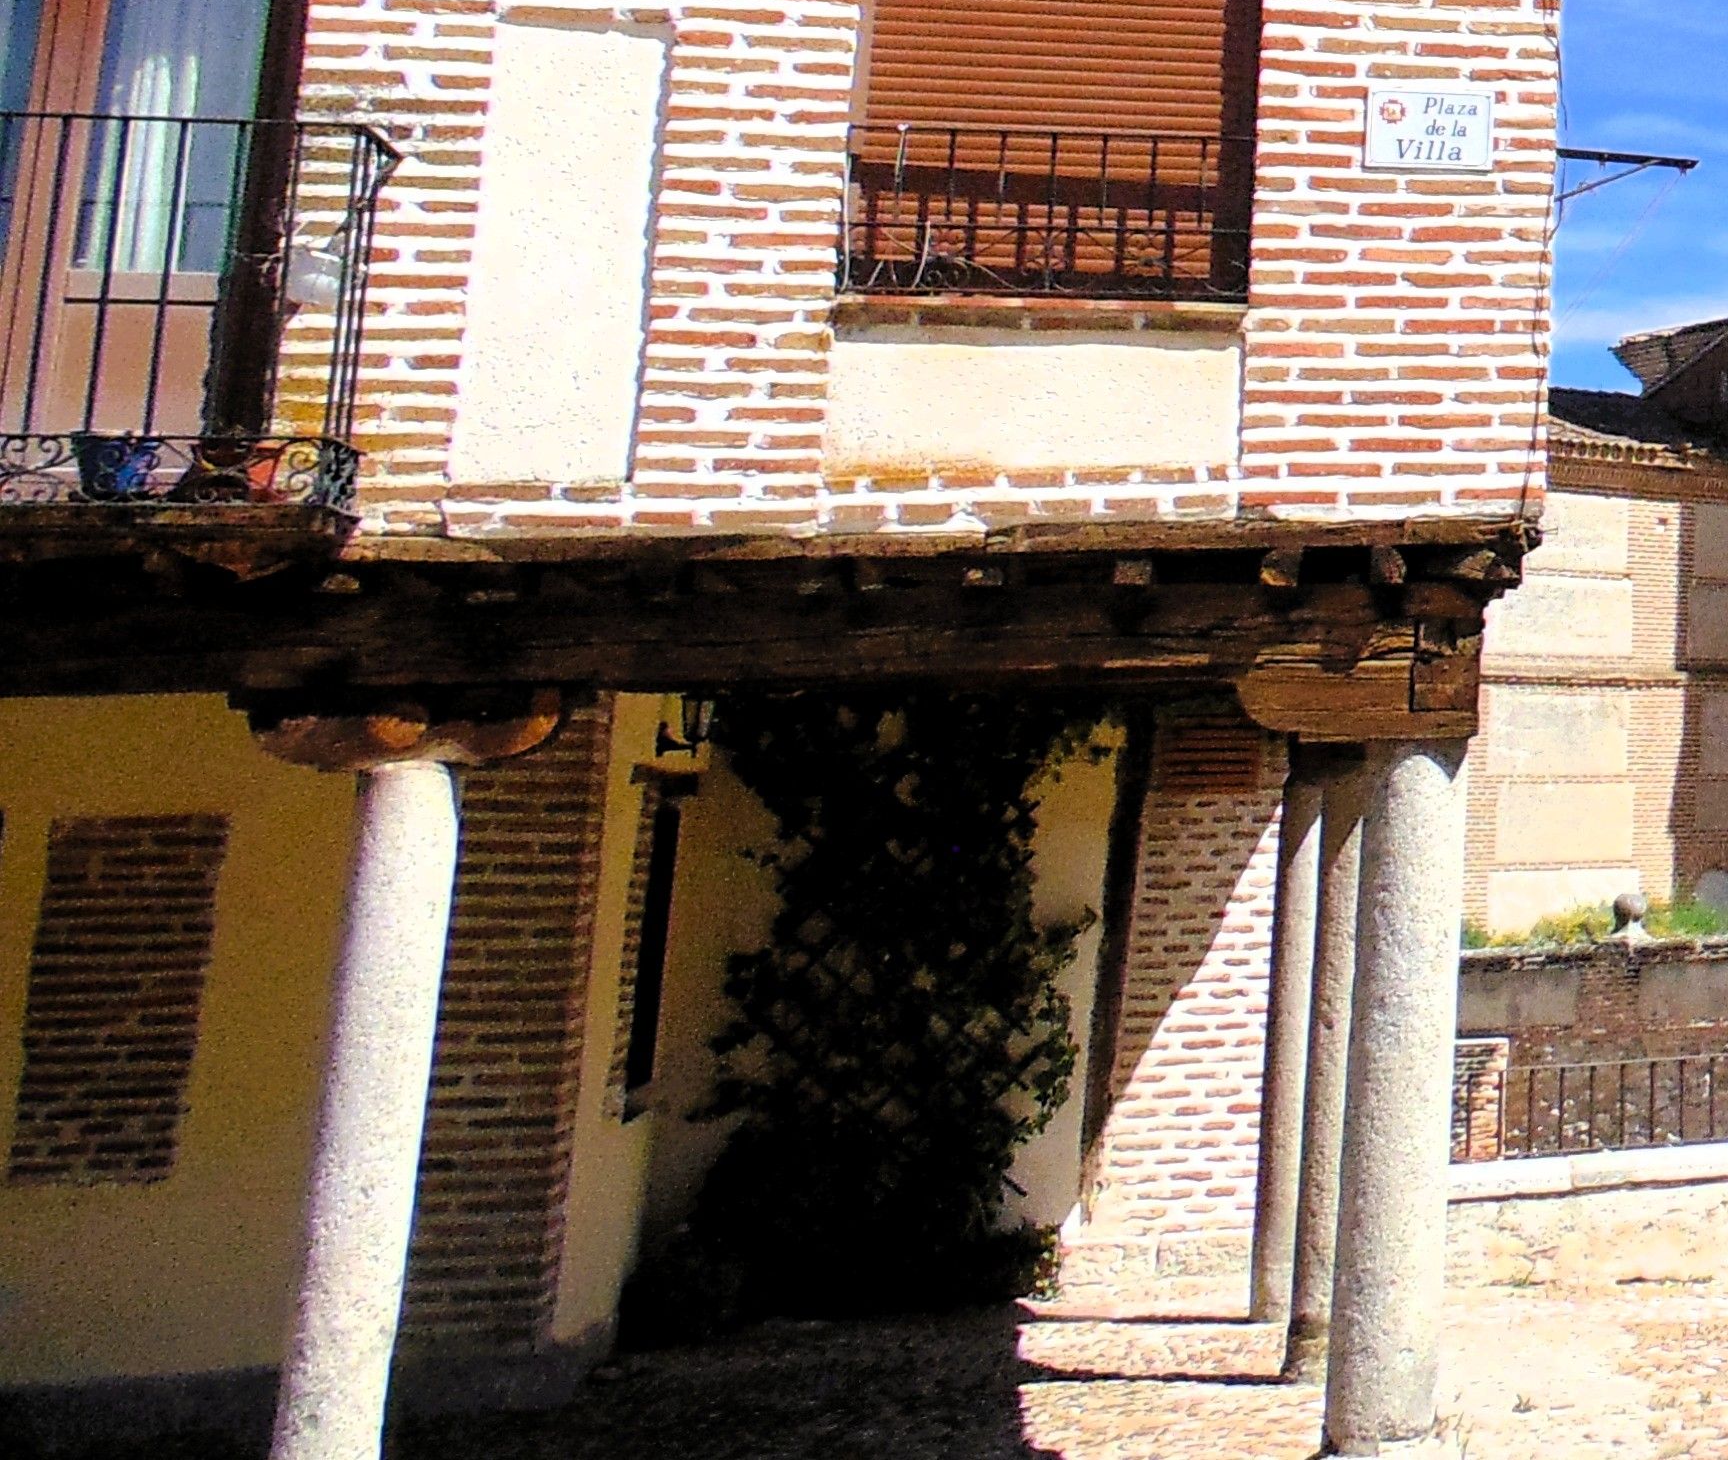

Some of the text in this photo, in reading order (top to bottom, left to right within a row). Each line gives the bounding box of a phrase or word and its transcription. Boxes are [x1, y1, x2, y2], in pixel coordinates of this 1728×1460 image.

[1423, 96, 1478, 116] Plaza
[1425, 119, 1467, 137] de la
[1396, 138, 1462, 161] Villa
